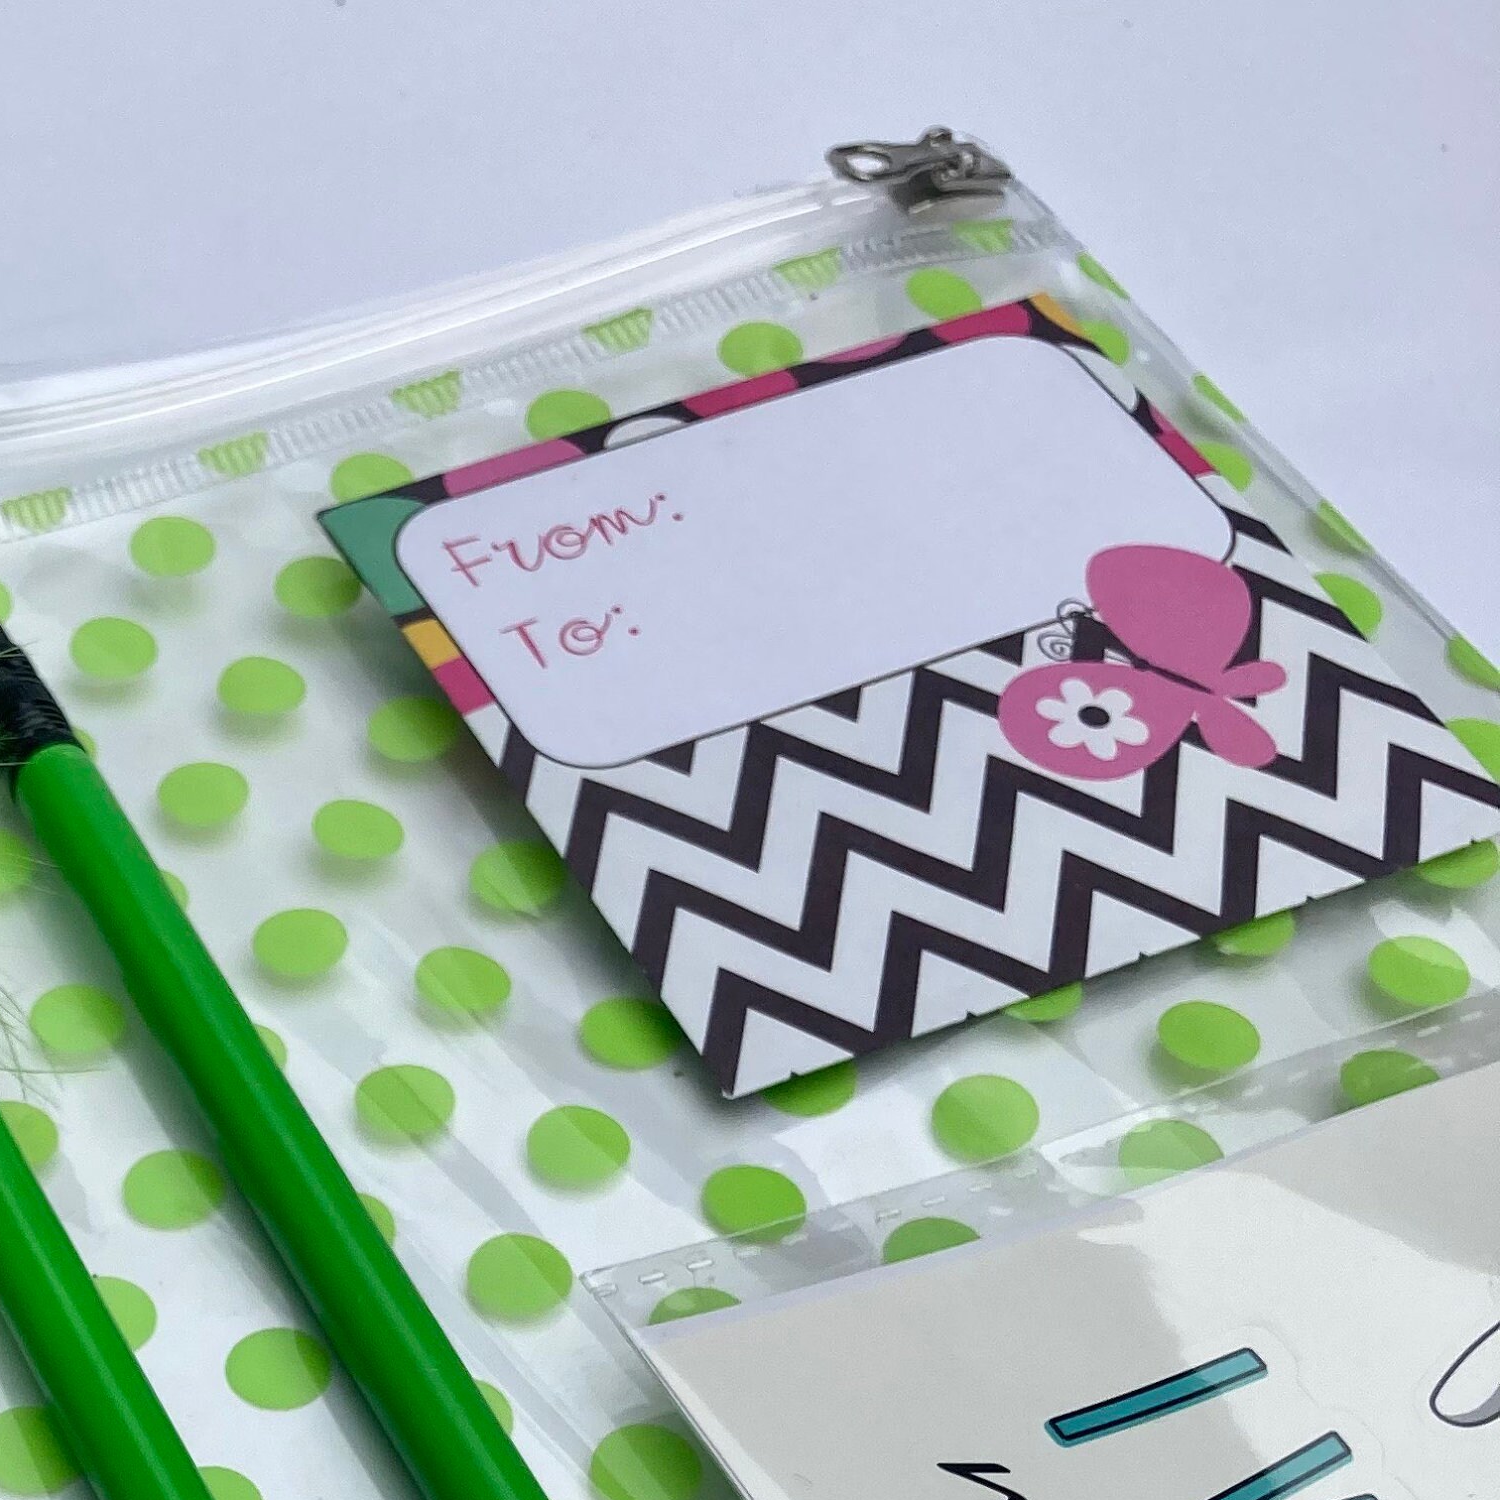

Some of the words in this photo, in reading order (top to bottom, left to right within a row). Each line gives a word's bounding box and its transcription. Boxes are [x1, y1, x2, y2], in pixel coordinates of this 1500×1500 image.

[442, 493, 684, 587] From:
[498, 605, 641, 669] To:
[1045, 1347, 1267, 1447] I
